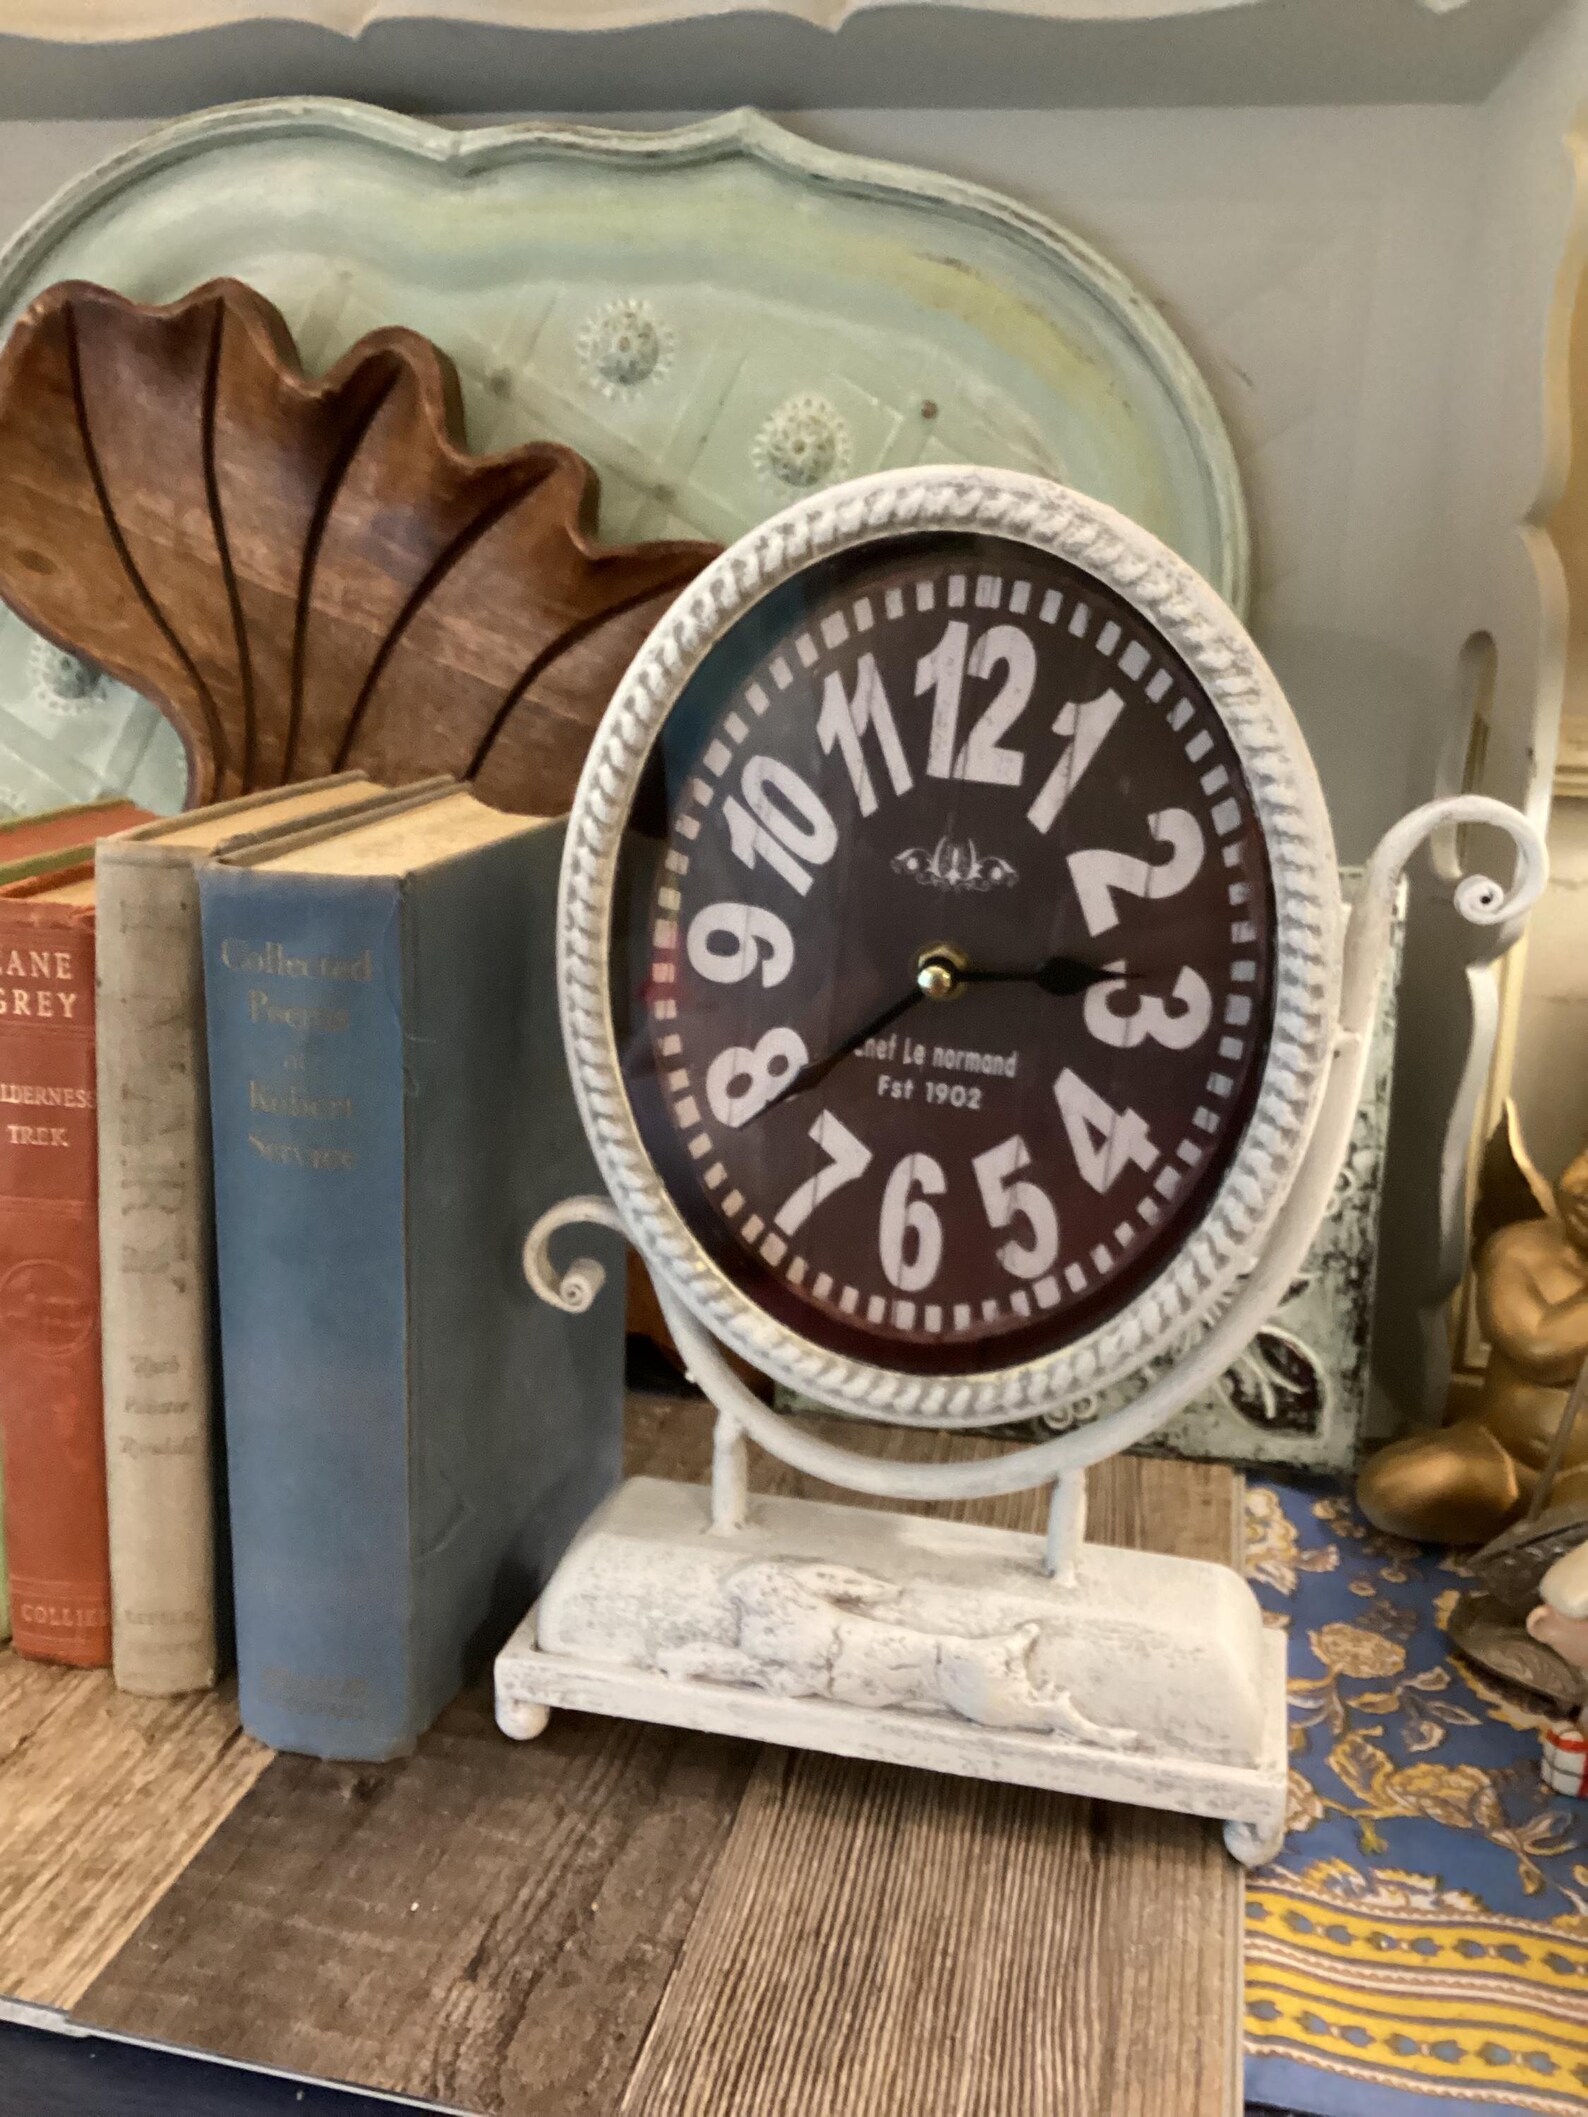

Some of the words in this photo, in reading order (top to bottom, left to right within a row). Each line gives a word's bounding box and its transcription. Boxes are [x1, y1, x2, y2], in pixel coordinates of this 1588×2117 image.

[817, 651, 914, 818] 11
[914, 620, 1037, 786] 12
[1026, 688, 1124, 834] 1
[722, 755, 839, 896] 10
[1066, 808, 1205, 938] 2
[0, 950, 73, 979] ANE
[687, 902, 794, 988] 9
[1084, 960, 1212, 1049] 3
[7, 1125, 70, 1147] TREK
[706, 1027, 809, 1128] 8
[925, 1081, 983, 1110] 1902
[1053, 1067, 1160, 1194] 4
[775, 1108, 873, 1237] 7
[879, 1153, 946, 1292] 6
[972, 1135, 1059, 1279] 5
